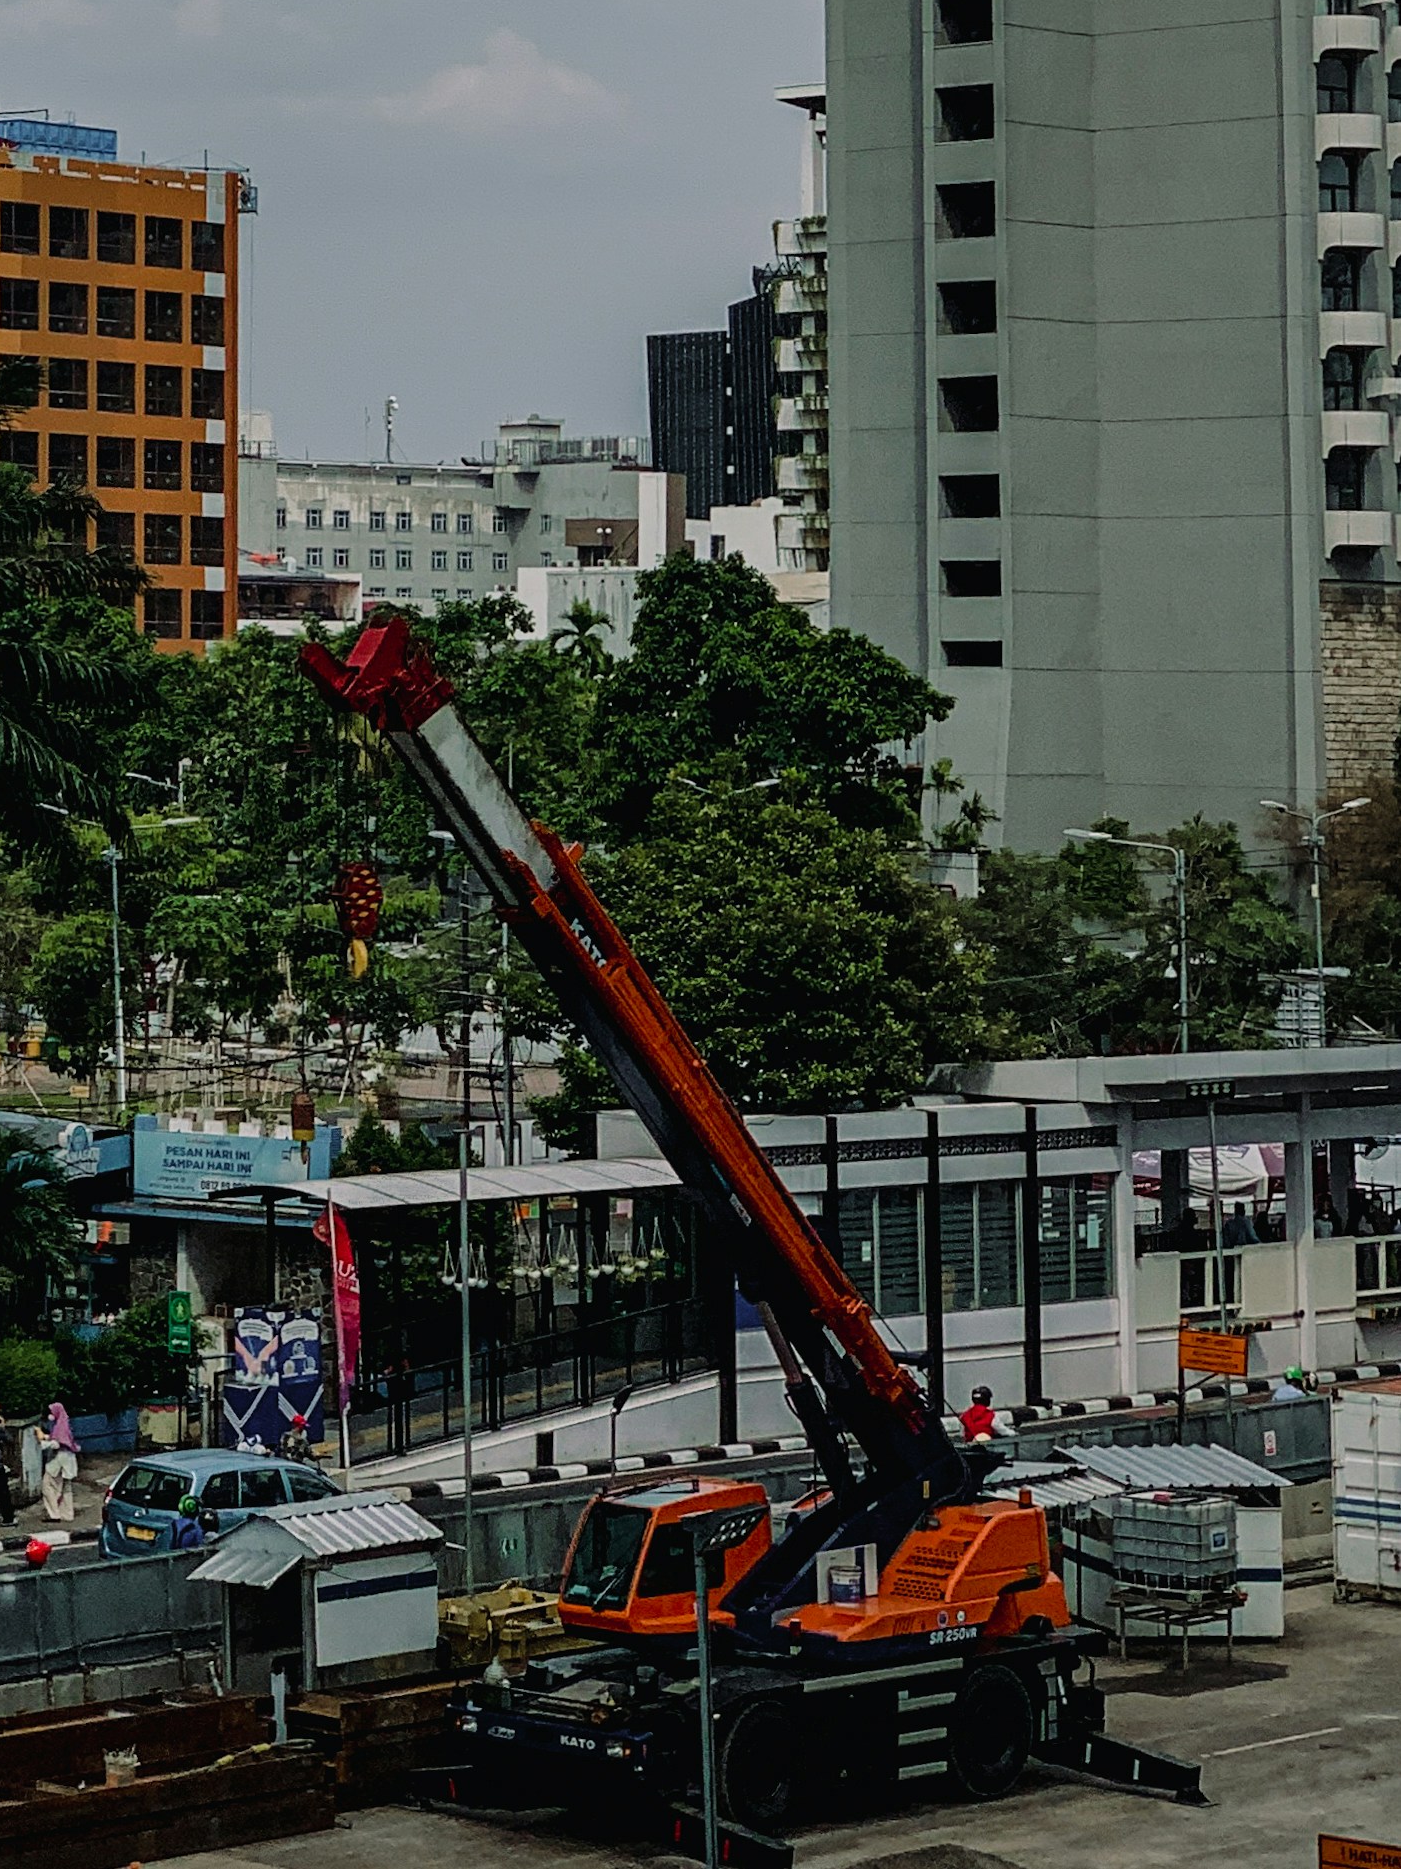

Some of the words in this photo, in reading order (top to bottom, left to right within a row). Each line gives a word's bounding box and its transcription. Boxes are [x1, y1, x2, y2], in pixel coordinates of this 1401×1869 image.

[166, 1145, 203, 1157] PESAN
[206, 1148, 233, 1160] HARI
[235, 1150, 251, 1160] INI
[162, 1158, 204, 1169] SAMPAI
[207, 1161, 234, 1171] HARI
[559, 1734, 596, 1750] KATO
